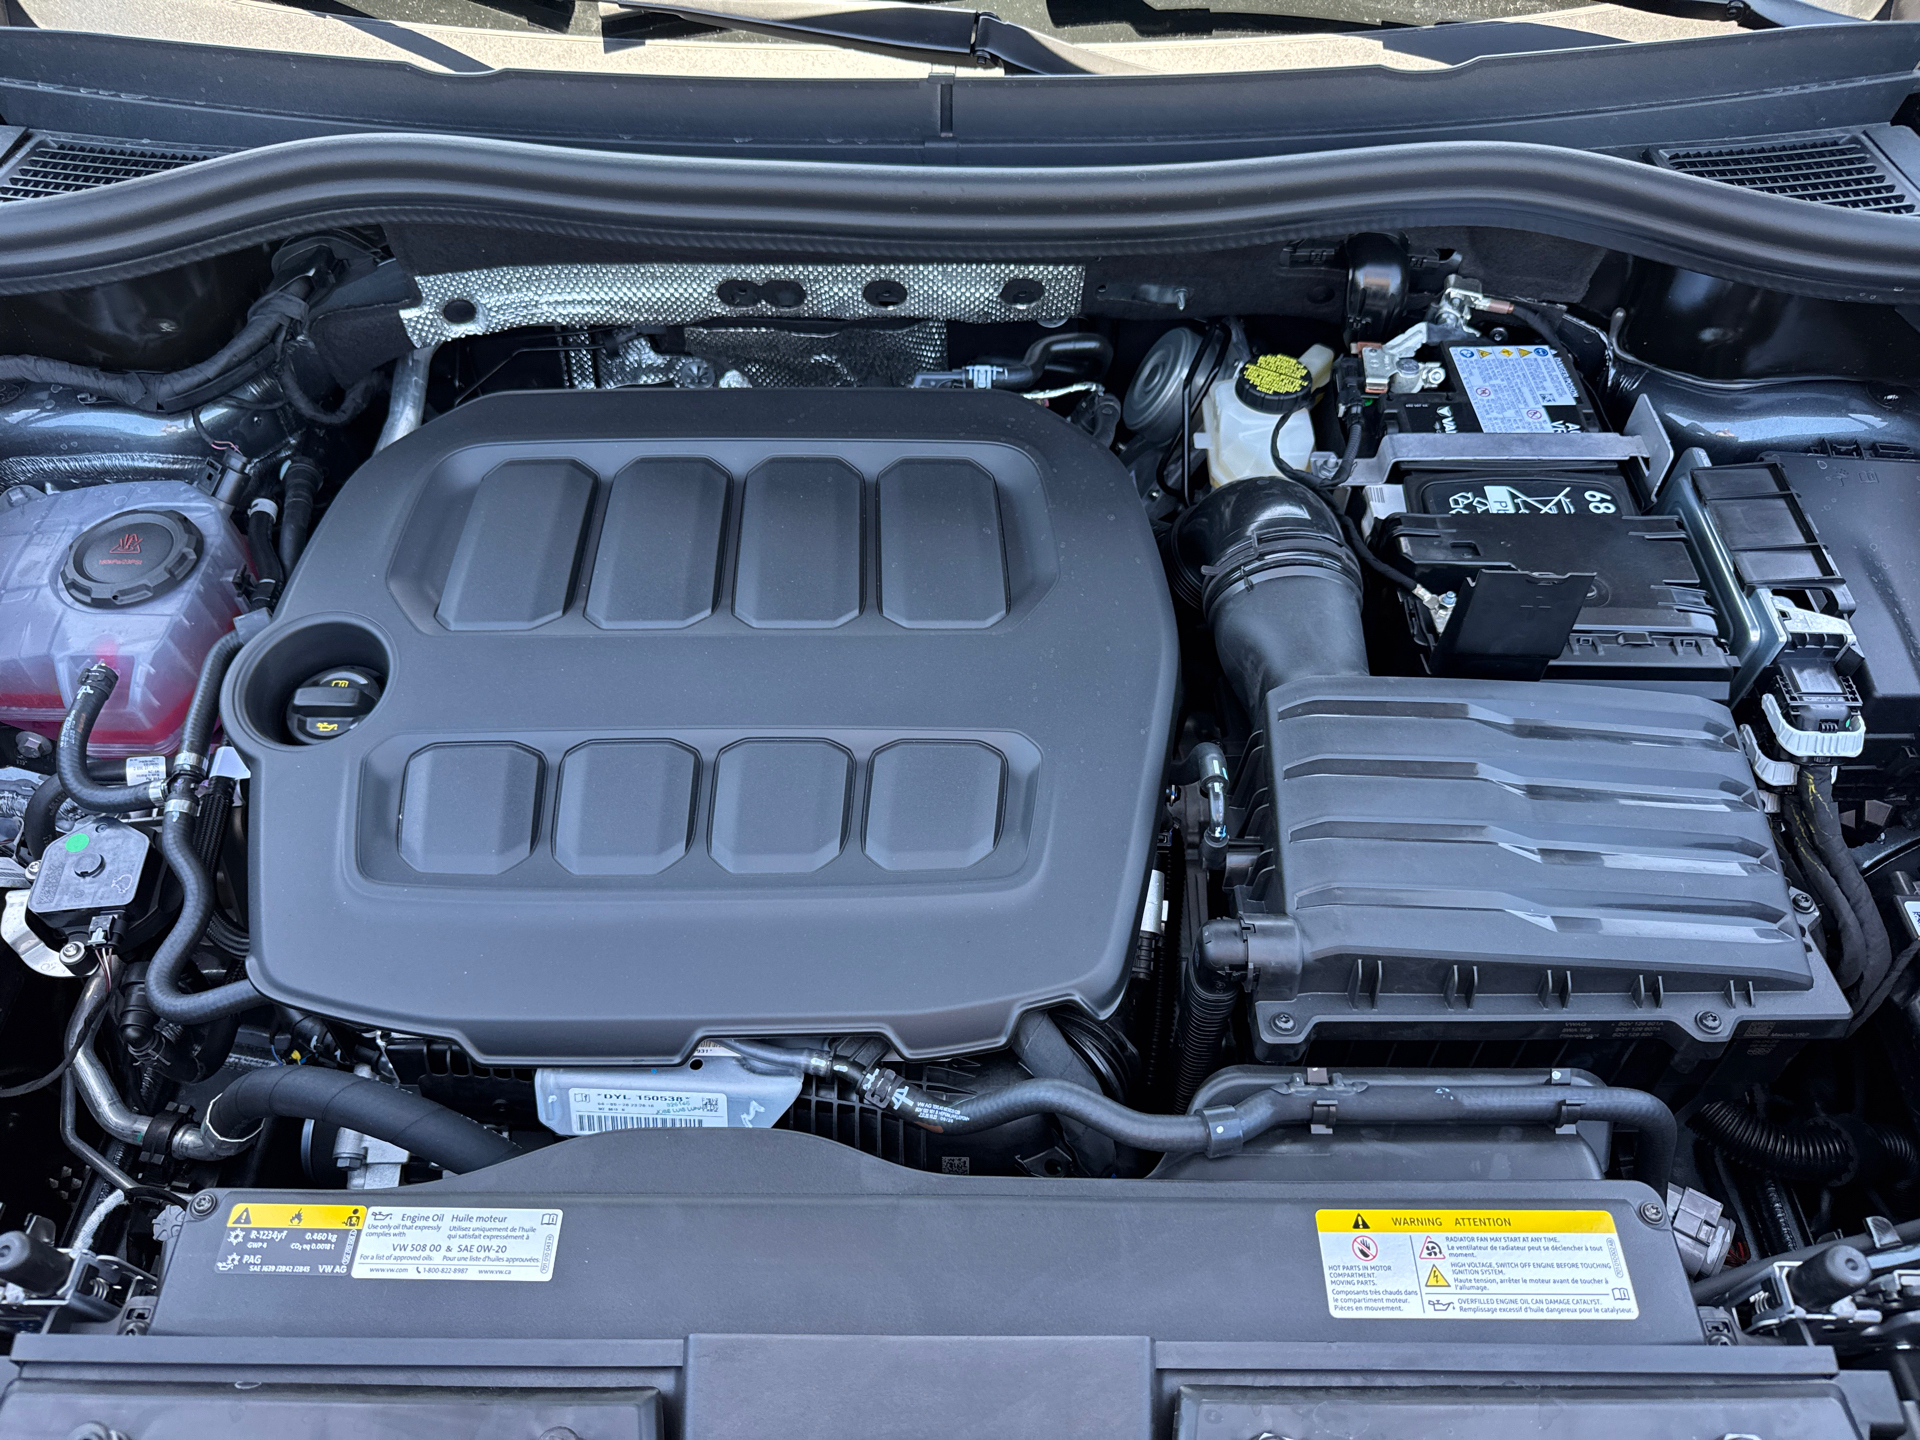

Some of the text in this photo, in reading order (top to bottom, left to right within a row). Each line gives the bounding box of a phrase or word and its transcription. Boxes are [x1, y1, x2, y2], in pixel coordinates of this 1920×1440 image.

[1584, 490, 1616, 514] 68
[401, 1214, 431, 1224] Engine
[432, 1214, 444, 1222] Oil
[451, 1214, 474, 1222] Huile
[1391, 1217, 1511, 1227] WARNING ATTENTION
[250, 1230, 338, 1242] R-1234yf 0.460 kg
[392, 1243, 409, 1252] VW
[410, 1244, 427, 1252] 508
[429, 1244, 442, 1252] 00
[457, 1245, 474, 1253] SAE
[476, 1245, 507, 1253] 0W-20
[242, 1255, 262, 1264] PAG
